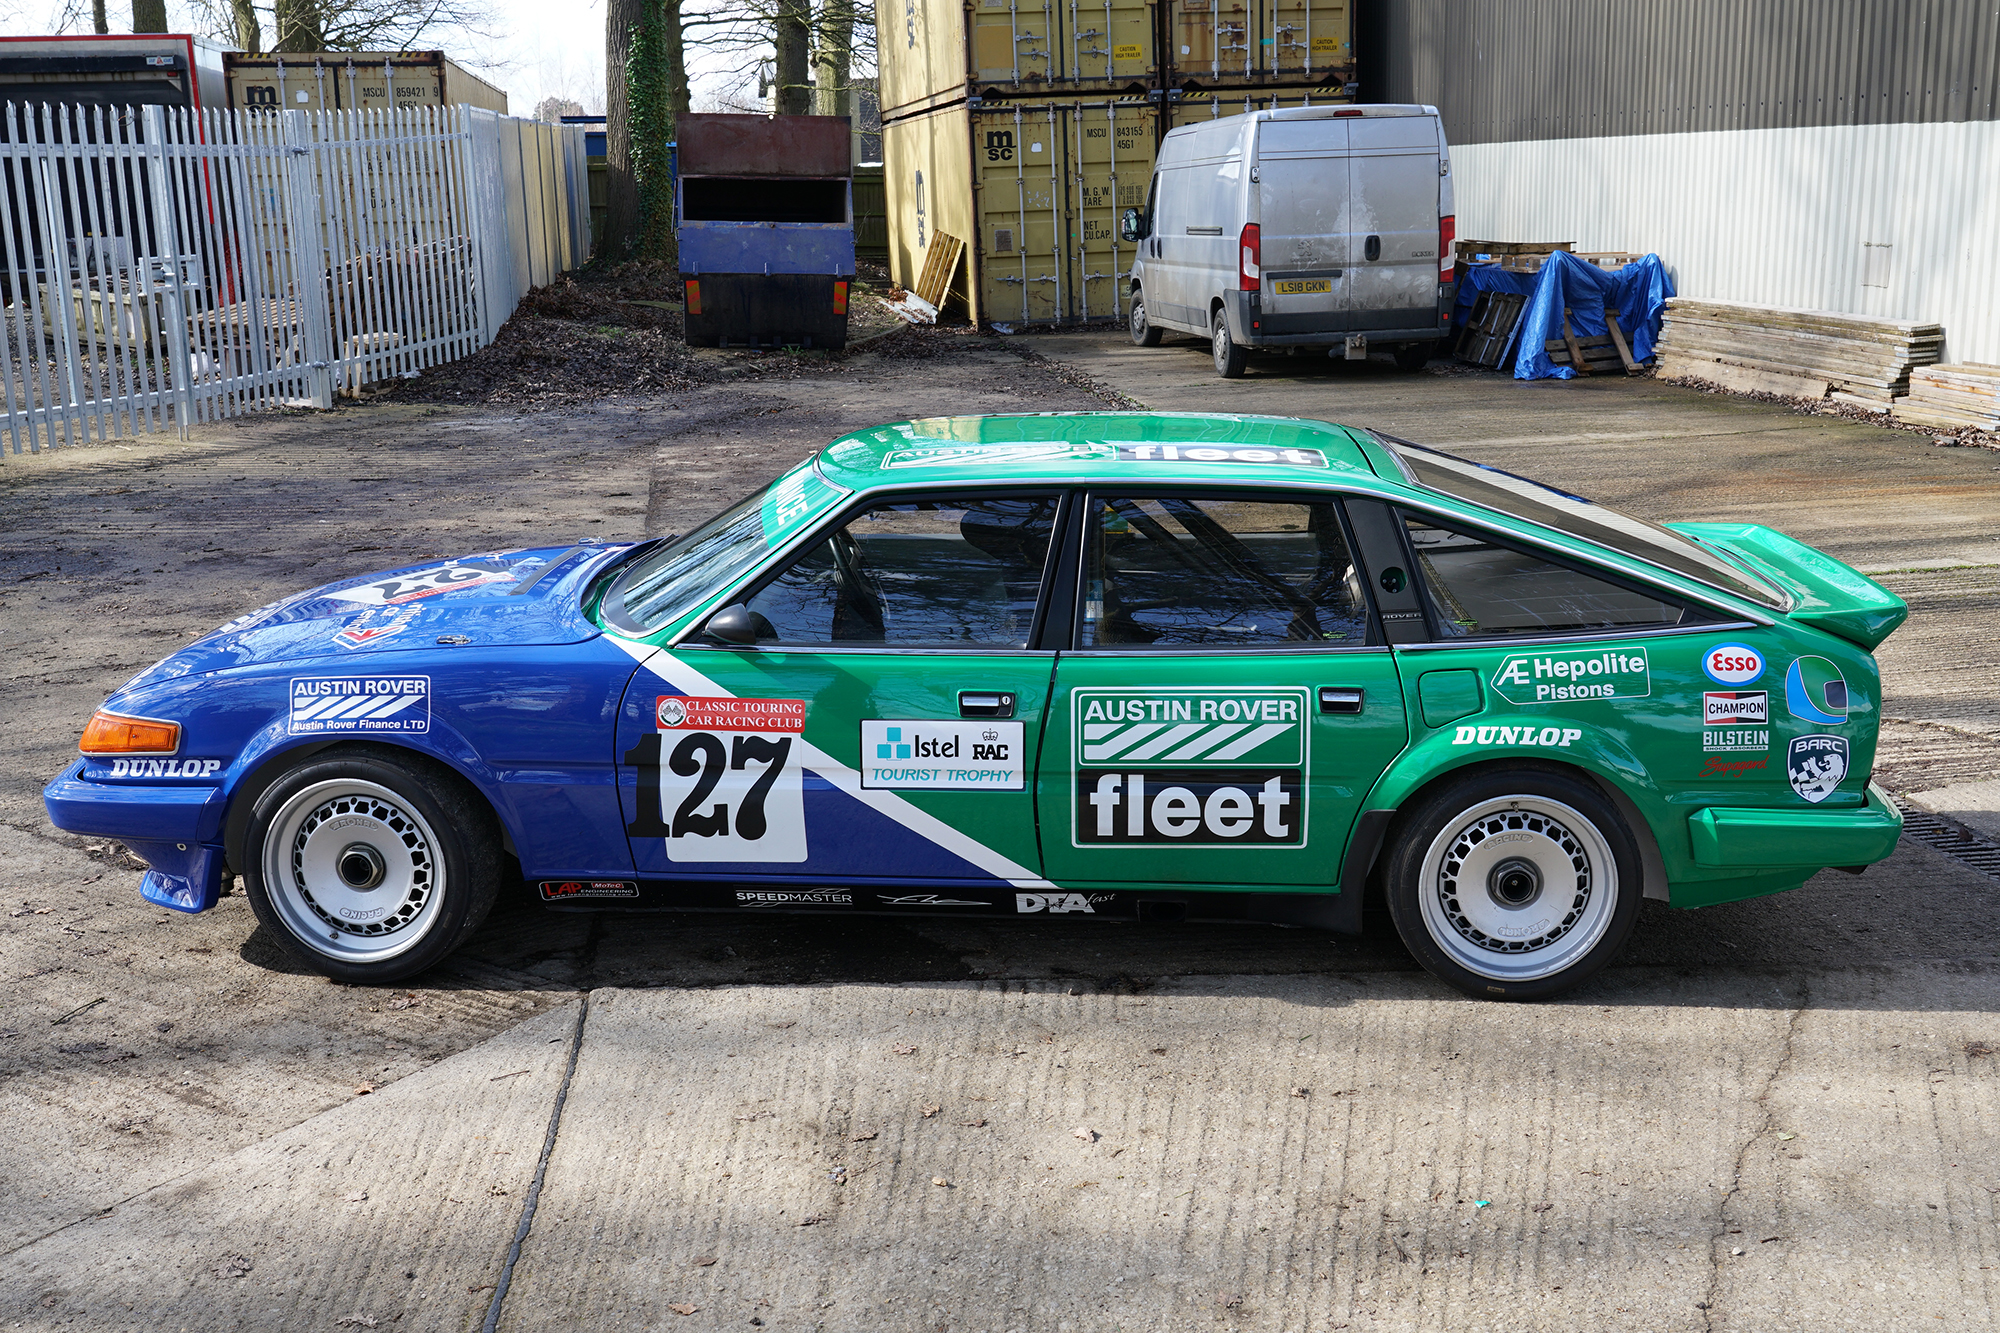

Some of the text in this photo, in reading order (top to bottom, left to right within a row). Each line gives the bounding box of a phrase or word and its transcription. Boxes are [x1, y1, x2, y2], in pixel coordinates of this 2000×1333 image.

[363, 86, 439, 98] MSCU 859421 9
[1087, 128, 1107, 138] MSCU
[1116, 126, 1143, 137] 843155
[1117, 139, 1134, 149] 45G1
[1083, 197, 1102, 206] TARE
[1084, 221, 1099, 230] NET
[1084, 230, 1111, 240] CU.CAP.
[1281, 280, 1326, 293] LS18 GKN
[1128, 445, 1312, 464] fleet
[1534, 653, 1645, 681] Hepolite
[1712, 653, 1757, 672] Esso
[294, 680, 426, 696] AUSTIN ROVER
[1536, 683, 1615, 700] Pistons
[686, 701, 740, 713] CLASSIC
[742, 702, 802, 714] TOURING
[1084, 700, 1298, 721] AUSTIN ROVER
[1709, 702, 1764, 715] CHAMPION
[292, 719, 426, 731] Austin Rover Finance LTD
[686, 715, 802, 729] CAR RACING CLUB
[1452, 726, 1582, 747] DUNLOP
[1703, 730, 1769, 746] BILSTEIN
[915, 735, 1009, 761] Istel RAC
[1795, 739, 1843, 753] BARC
[110, 759, 221, 778] DUNLOP
[1698, 754, 1771, 778] Supagard
[872, 768, 1014, 782] TOURIST TROPHY
[624, 732, 792, 841] 127
[1089, 773, 1290, 838] fleet
[1484, 834, 1534, 850] RACING
[544, 882, 582, 897] LAP
[736, 892, 852, 903] SPEEDMASTER
[1015, 893, 1096, 914] DTA
[339, 907, 385, 920] RACING
